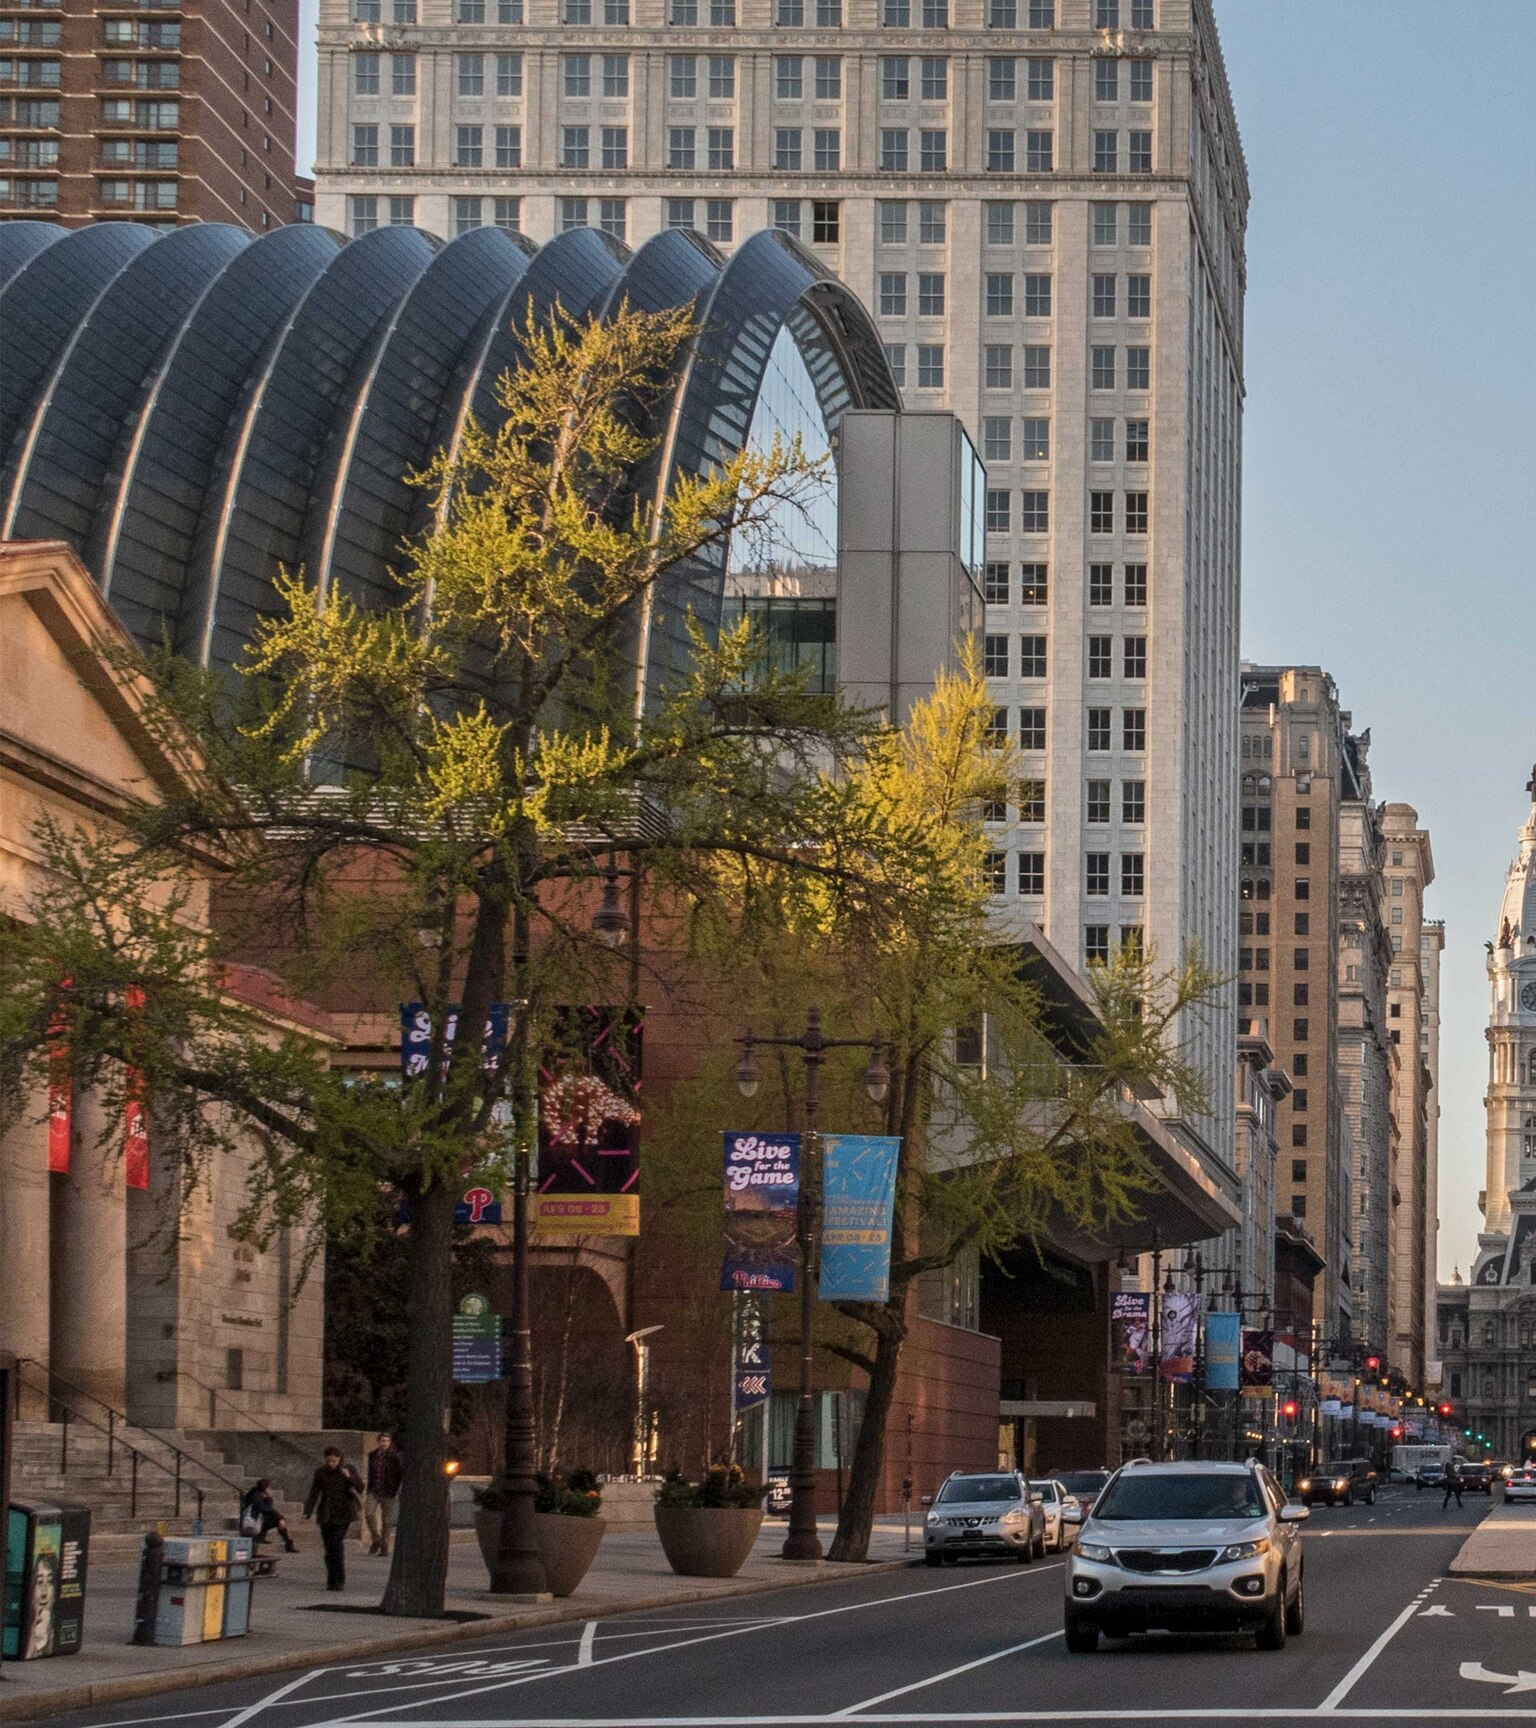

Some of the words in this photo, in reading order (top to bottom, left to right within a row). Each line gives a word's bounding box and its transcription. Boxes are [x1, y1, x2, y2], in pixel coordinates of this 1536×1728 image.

[730, 1136, 791, 1161] Live
[754, 1161, 771, 1171] for
[773, 1161, 790, 1171] the
[726, 1165, 794, 1191] Game
[1115, 1294, 1145, 1306] Live
[1112, 1309, 1147, 1319] Drama
